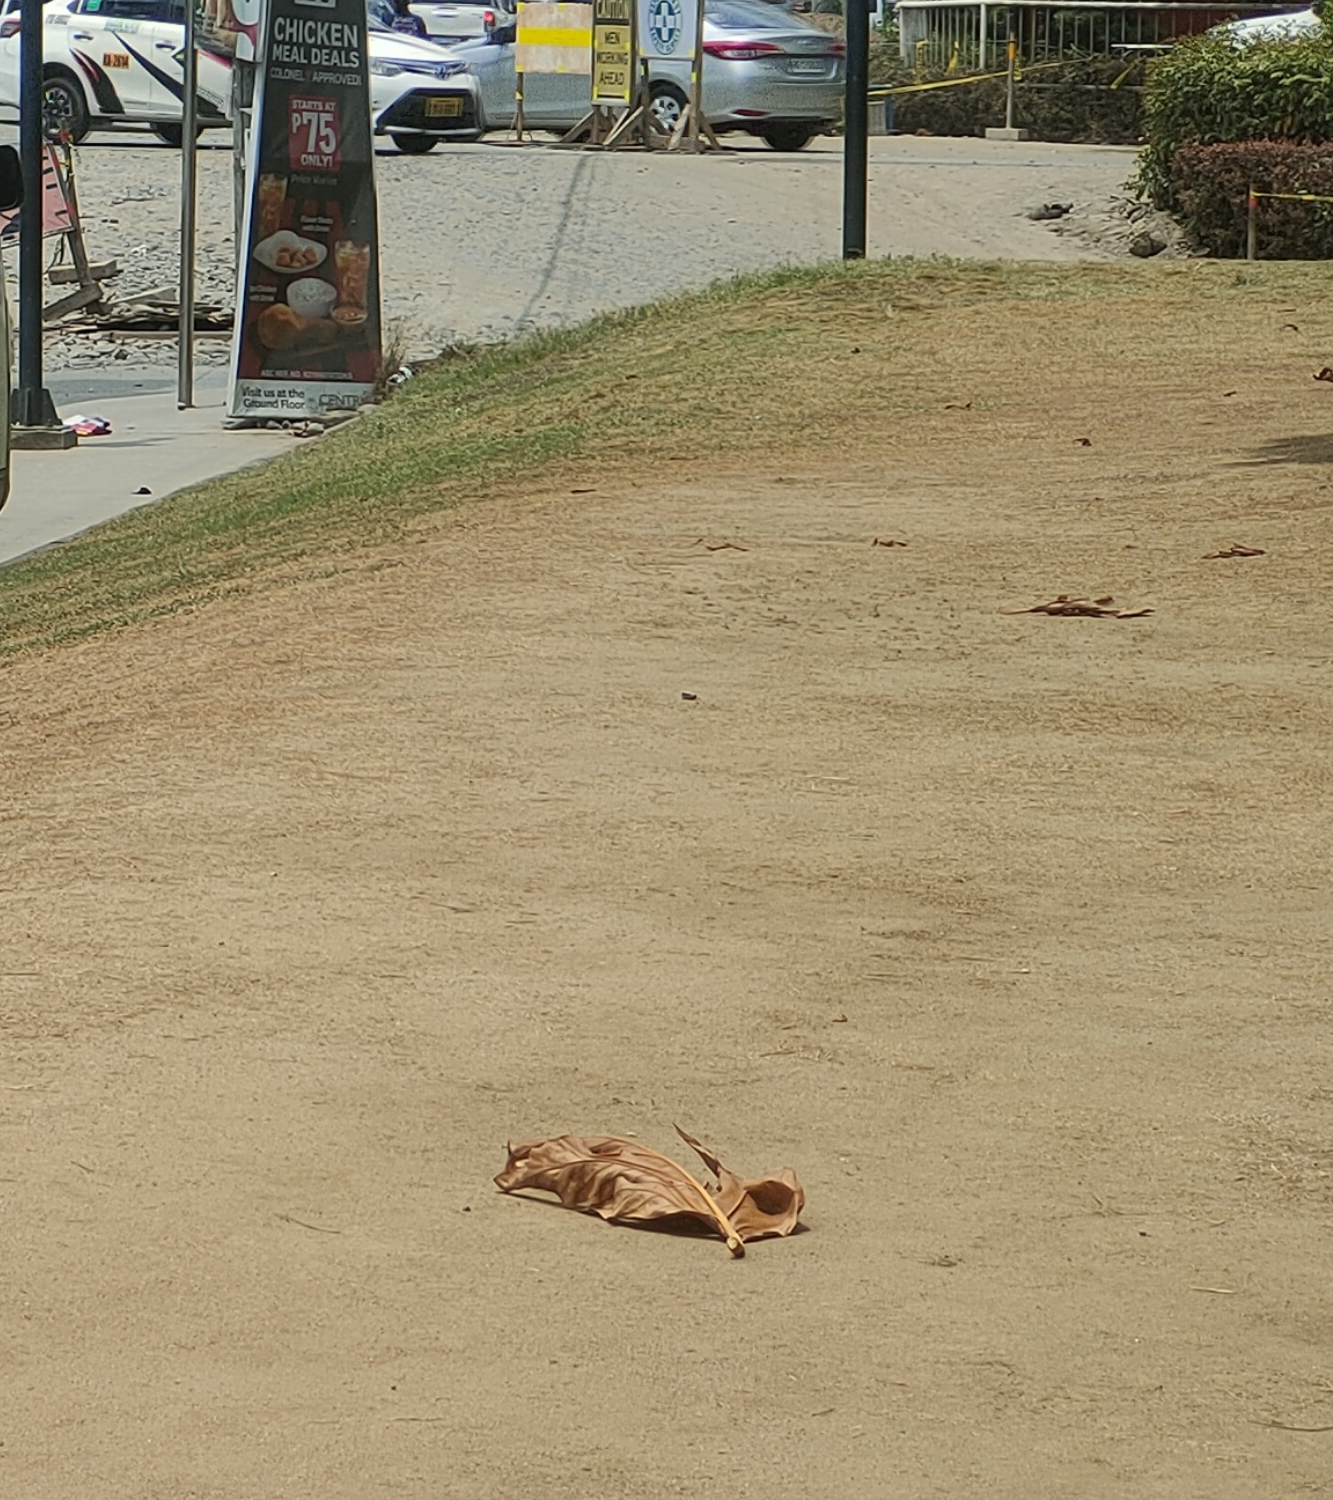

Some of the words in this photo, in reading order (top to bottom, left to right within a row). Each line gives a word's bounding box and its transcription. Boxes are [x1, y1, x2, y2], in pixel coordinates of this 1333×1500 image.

[273, 16, 358, 49] CHICKEN
[604, 31, 621, 45] MEN
[272, 43, 308, 65] MEAL
[310, 47, 360, 69] DEALS
[596, 51, 629, 66] WORKING
[598, 71, 624, 85] AHEAD
[292, 99, 323, 111] STARTS
[324, 102, 336, 111] AT
[300, 154, 334, 167] ONLY!
[241, 386, 262, 397] Visit
[263, 389, 276, 397] us
[277, 388, 287, 397] at
[288, 388, 305, 398] the
[243, 398, 279, 409] Ground
[280, 399, 306, 409] Floor
